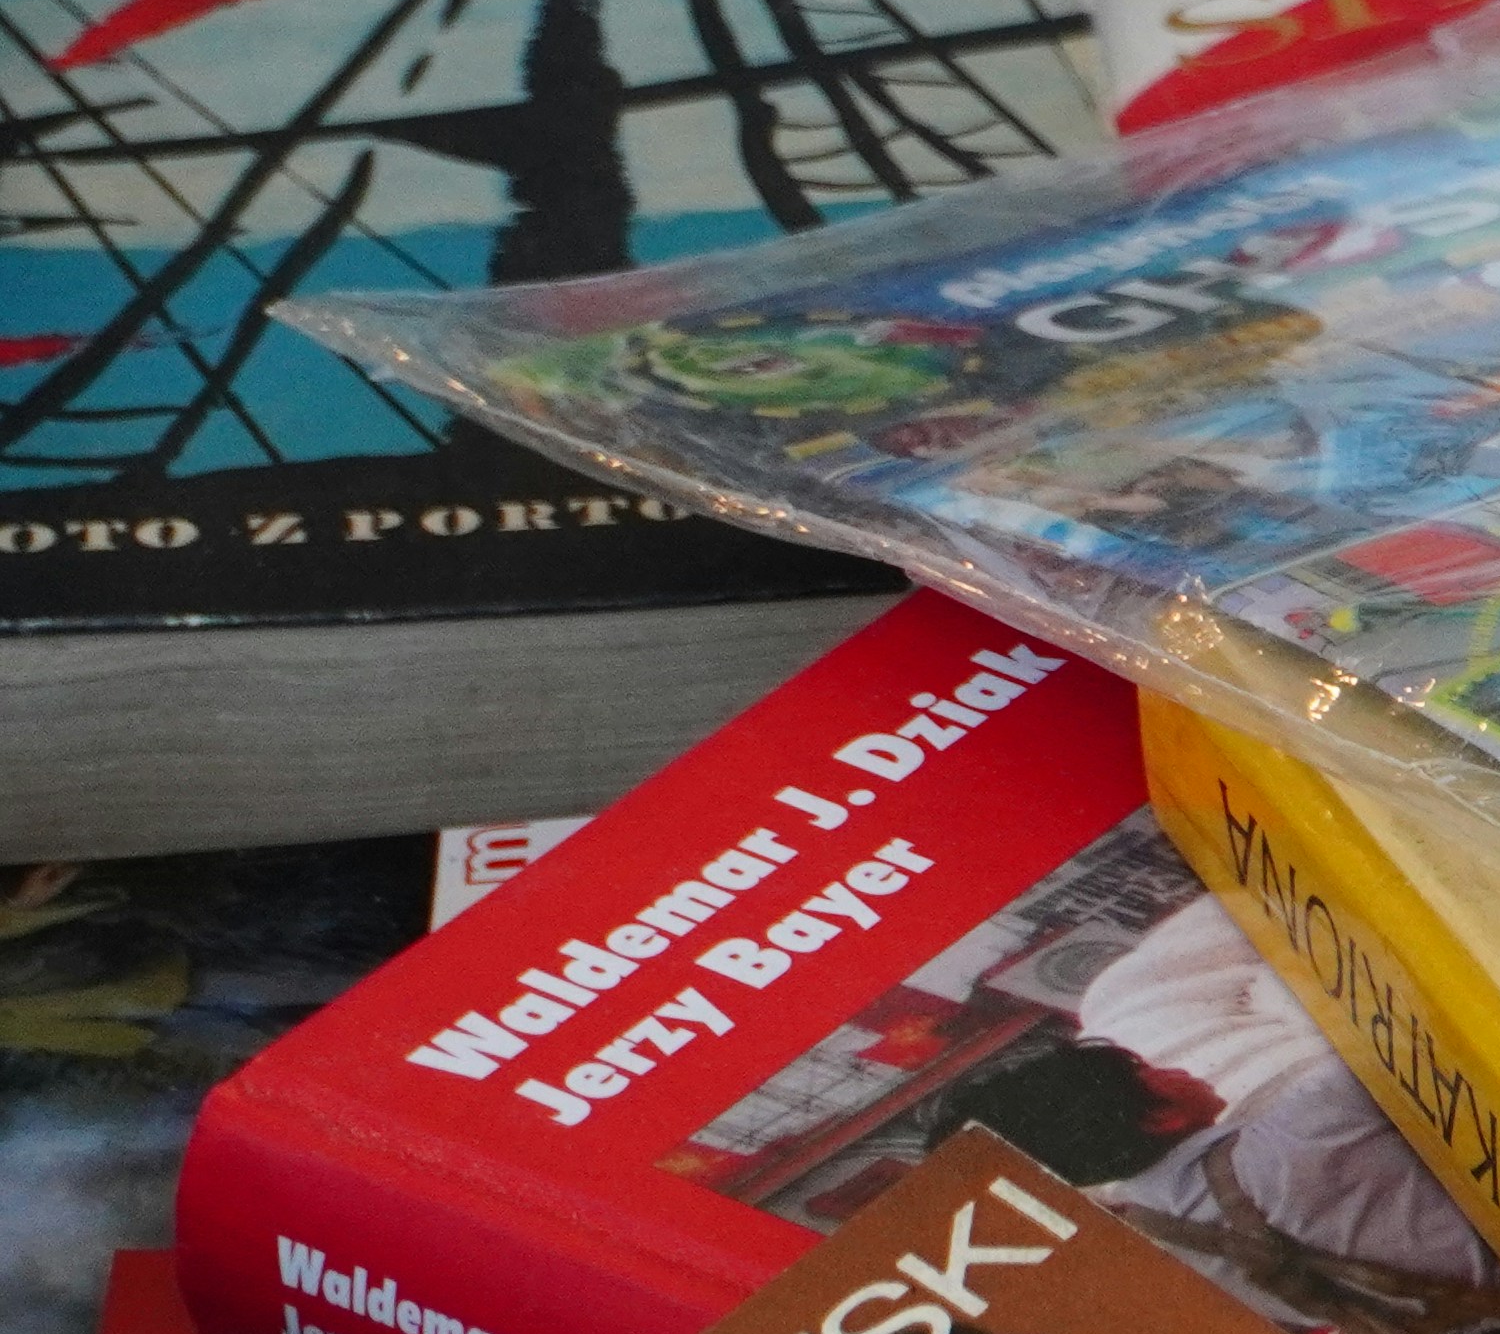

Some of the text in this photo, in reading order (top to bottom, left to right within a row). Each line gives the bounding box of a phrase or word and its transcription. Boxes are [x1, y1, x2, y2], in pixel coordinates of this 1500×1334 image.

[245, 512, 308, 545] Z
[409, 639, 1069, 1084] Waldemar J. Dziak
[513, 984, 737, 1132] Jerzy
[694, 836, 941, 993] Bayer
